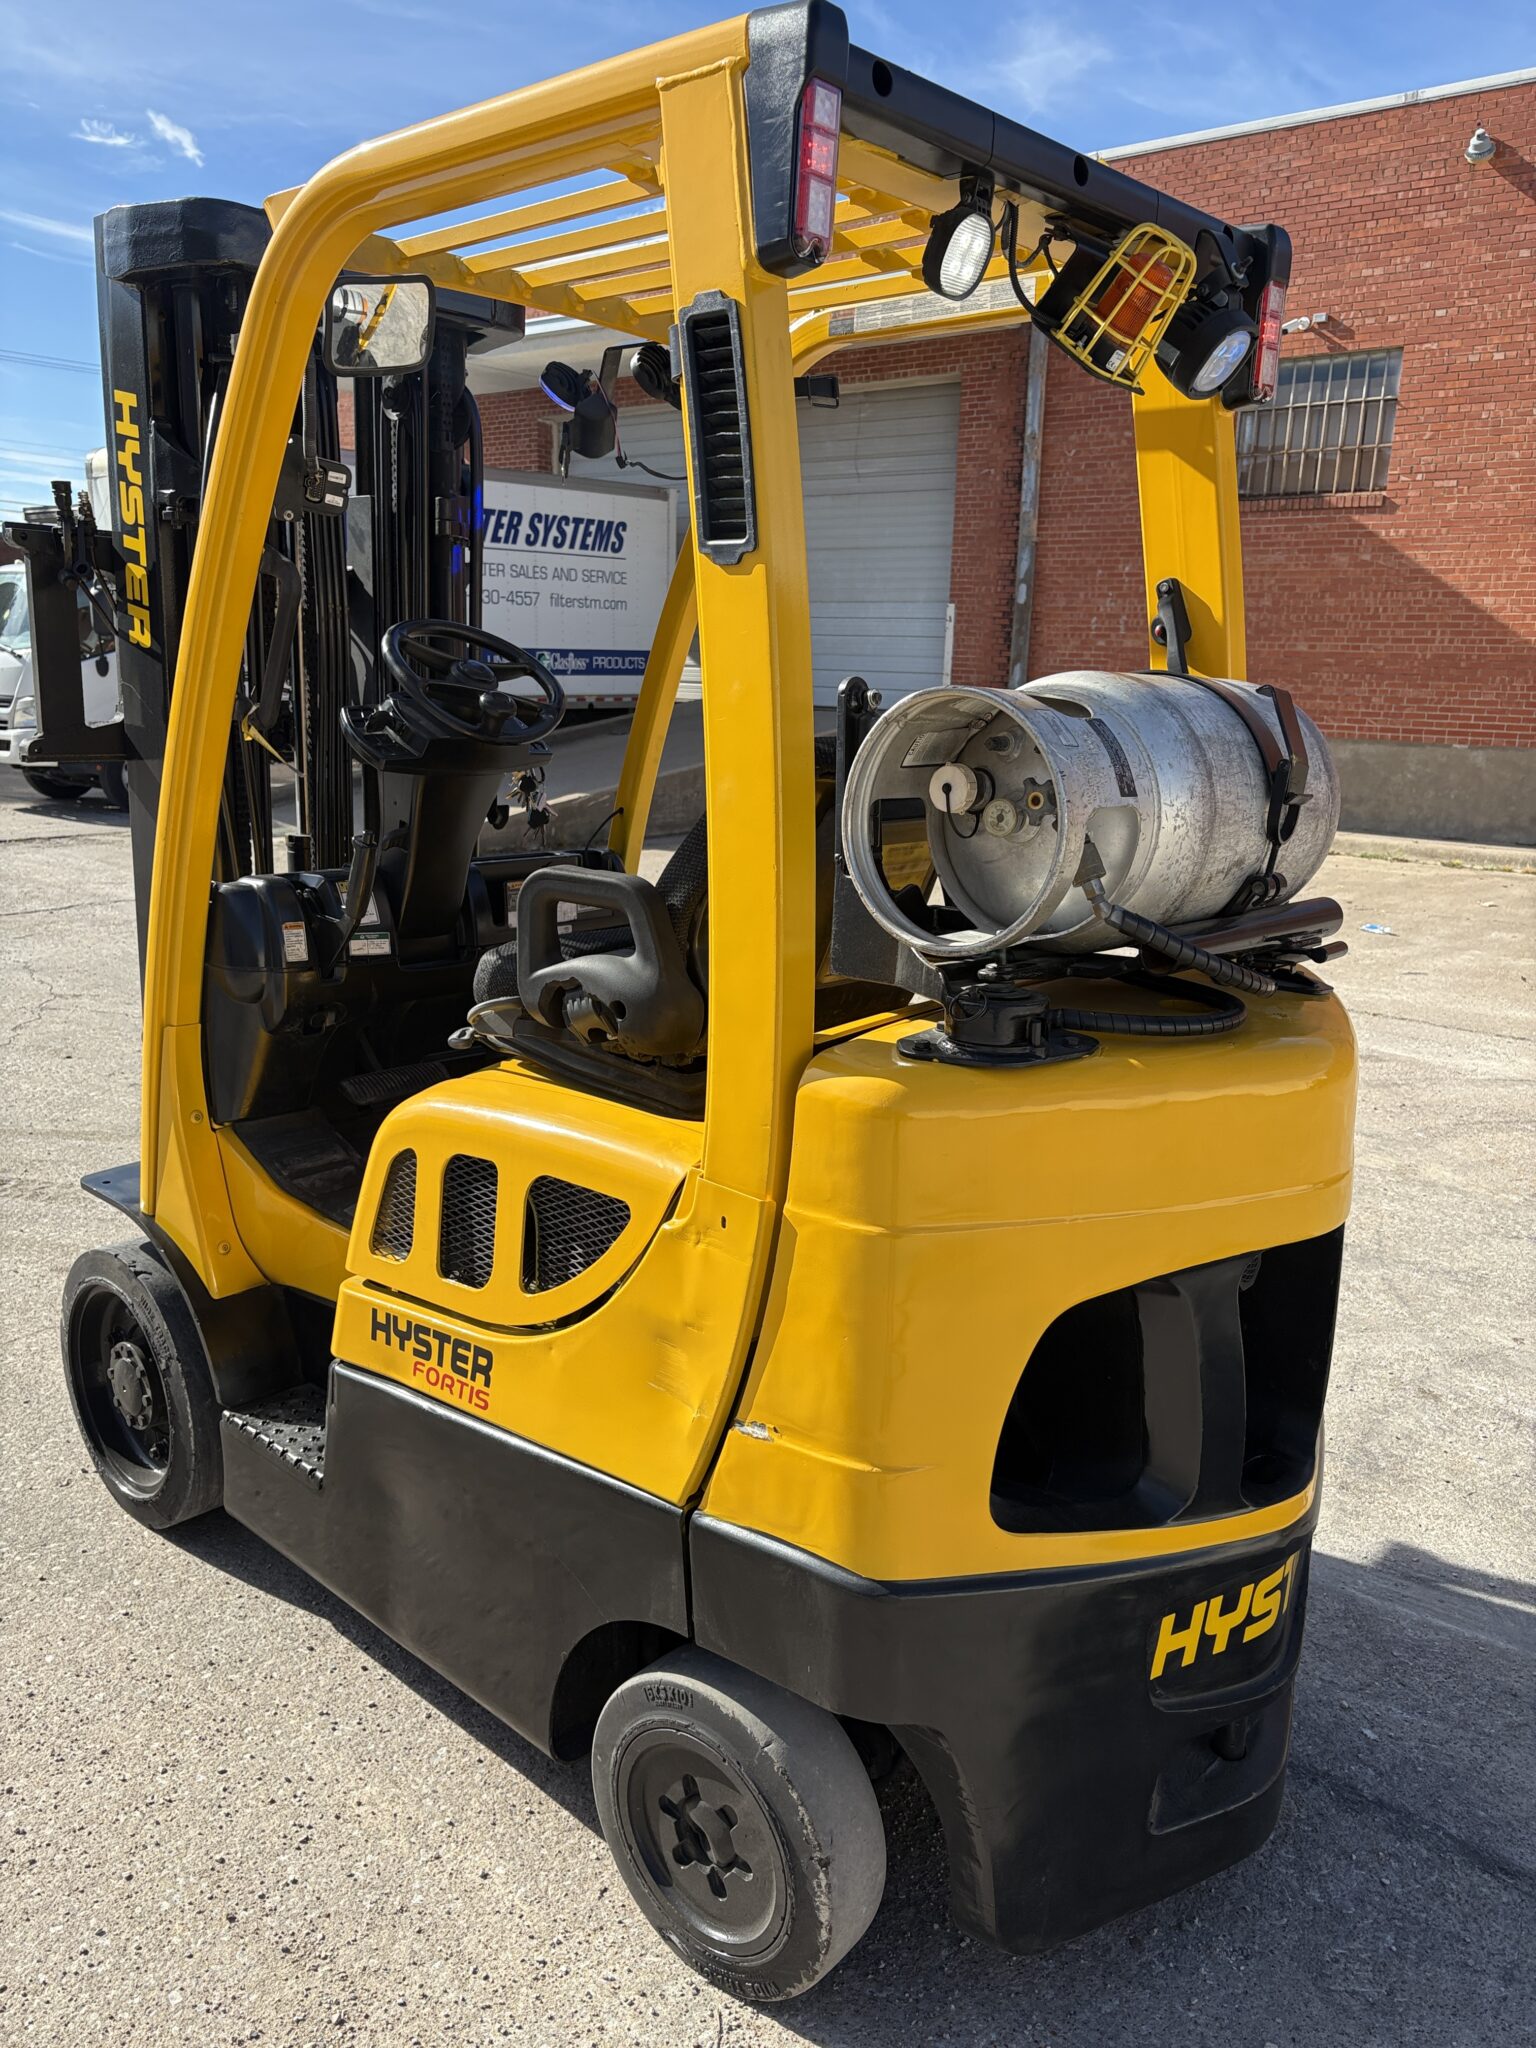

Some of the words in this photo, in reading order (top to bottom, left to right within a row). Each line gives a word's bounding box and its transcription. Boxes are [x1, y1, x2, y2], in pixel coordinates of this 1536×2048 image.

[114, 389, 151, 649] HYSTER
[483, 508, 523, 545] TER
[525, 512, 627, 554] SYSTEMS
[510, 563, 548, 580] SALES
[552, 567, 578, 582] AND
[582, 569, 627, 585] SERVICE
[482, 590, 540, 606] 30-4557
[550, 592, 627, 611] filterstm.com
[592, 656, 645, 670] PRODUCTS
[371, 1307, 493, 1388] HYSTER
[413, 1360, 490, 1411] FORTIS
[1150, 1550, 1300, 1680] HYST
